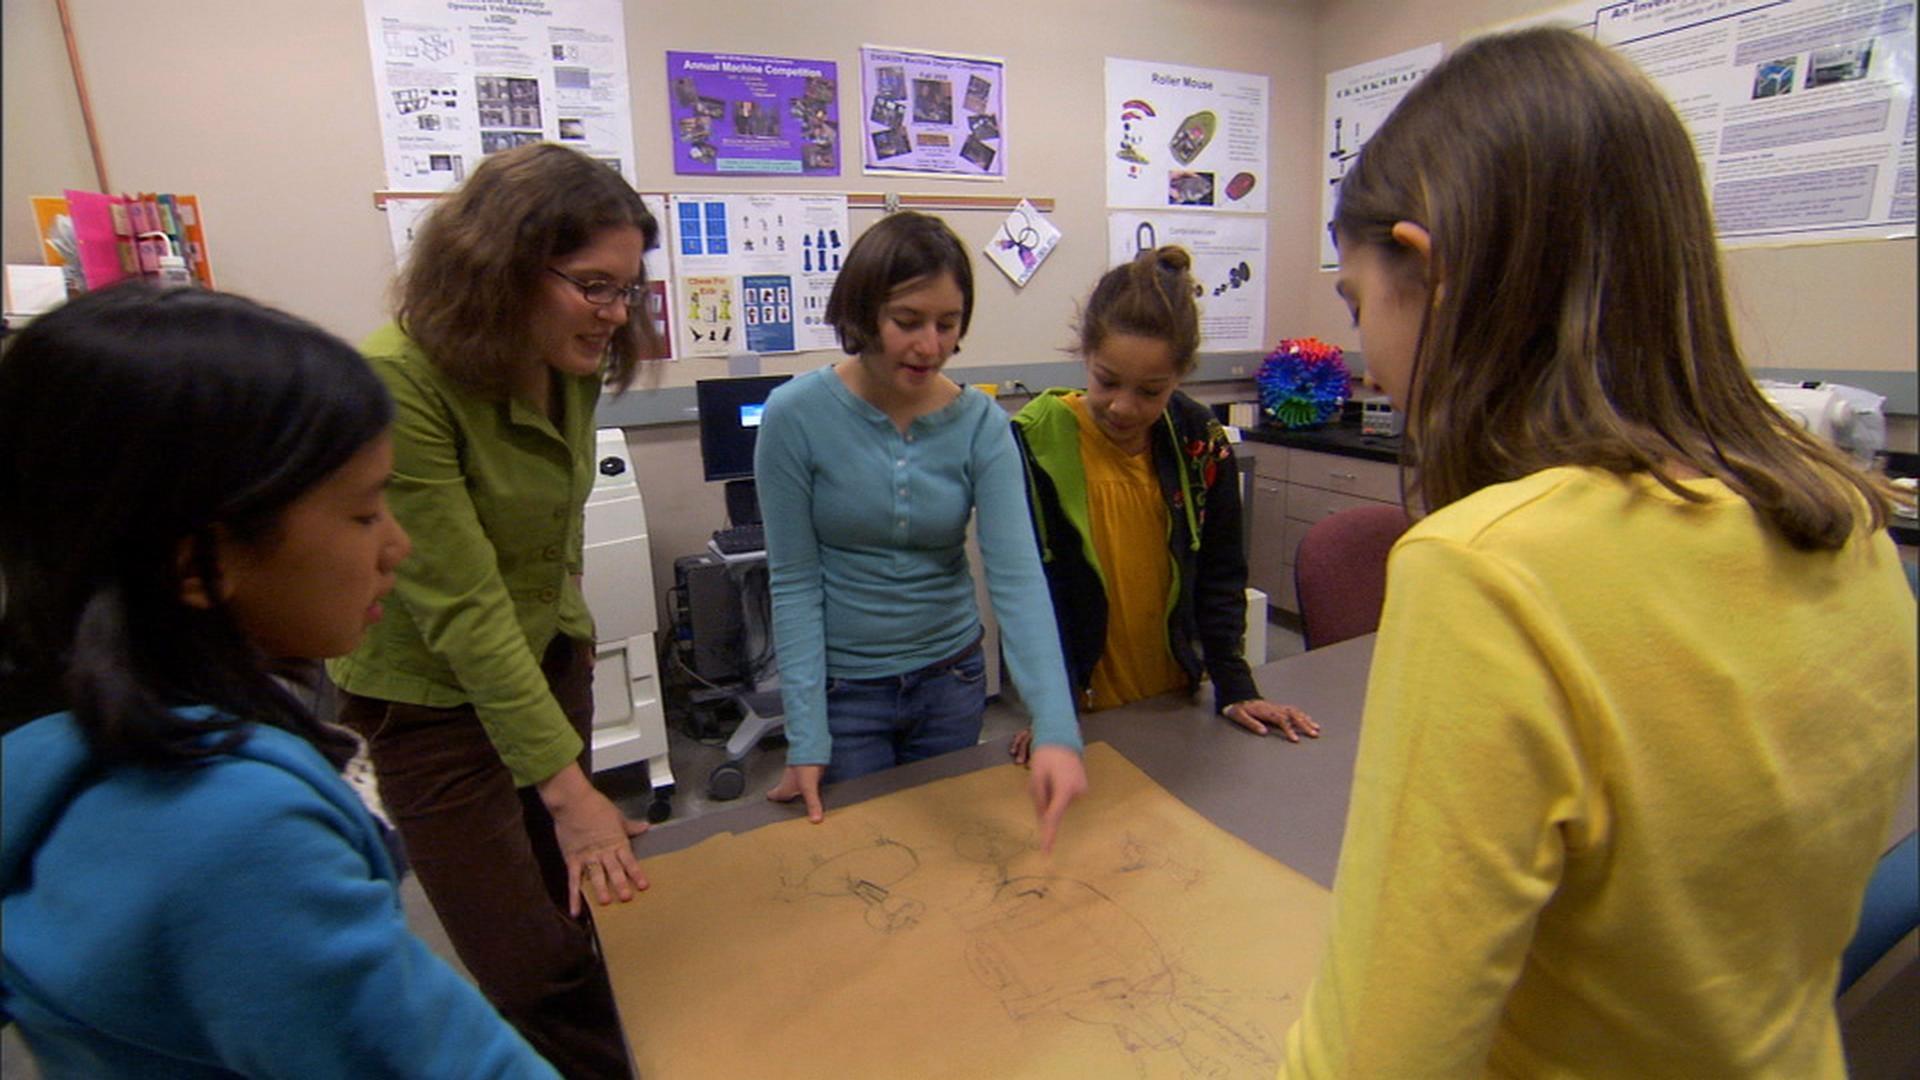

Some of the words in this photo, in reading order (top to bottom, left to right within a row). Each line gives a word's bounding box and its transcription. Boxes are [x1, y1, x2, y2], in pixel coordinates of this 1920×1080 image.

[684, 60, 720, 71] Annual
[722, 62, 763, 74] Machine
[765, 65, 823, 78] Competition
[1151, 72, 1181, 87] Roller
[1183, 76, 1214, 91] Mouse
